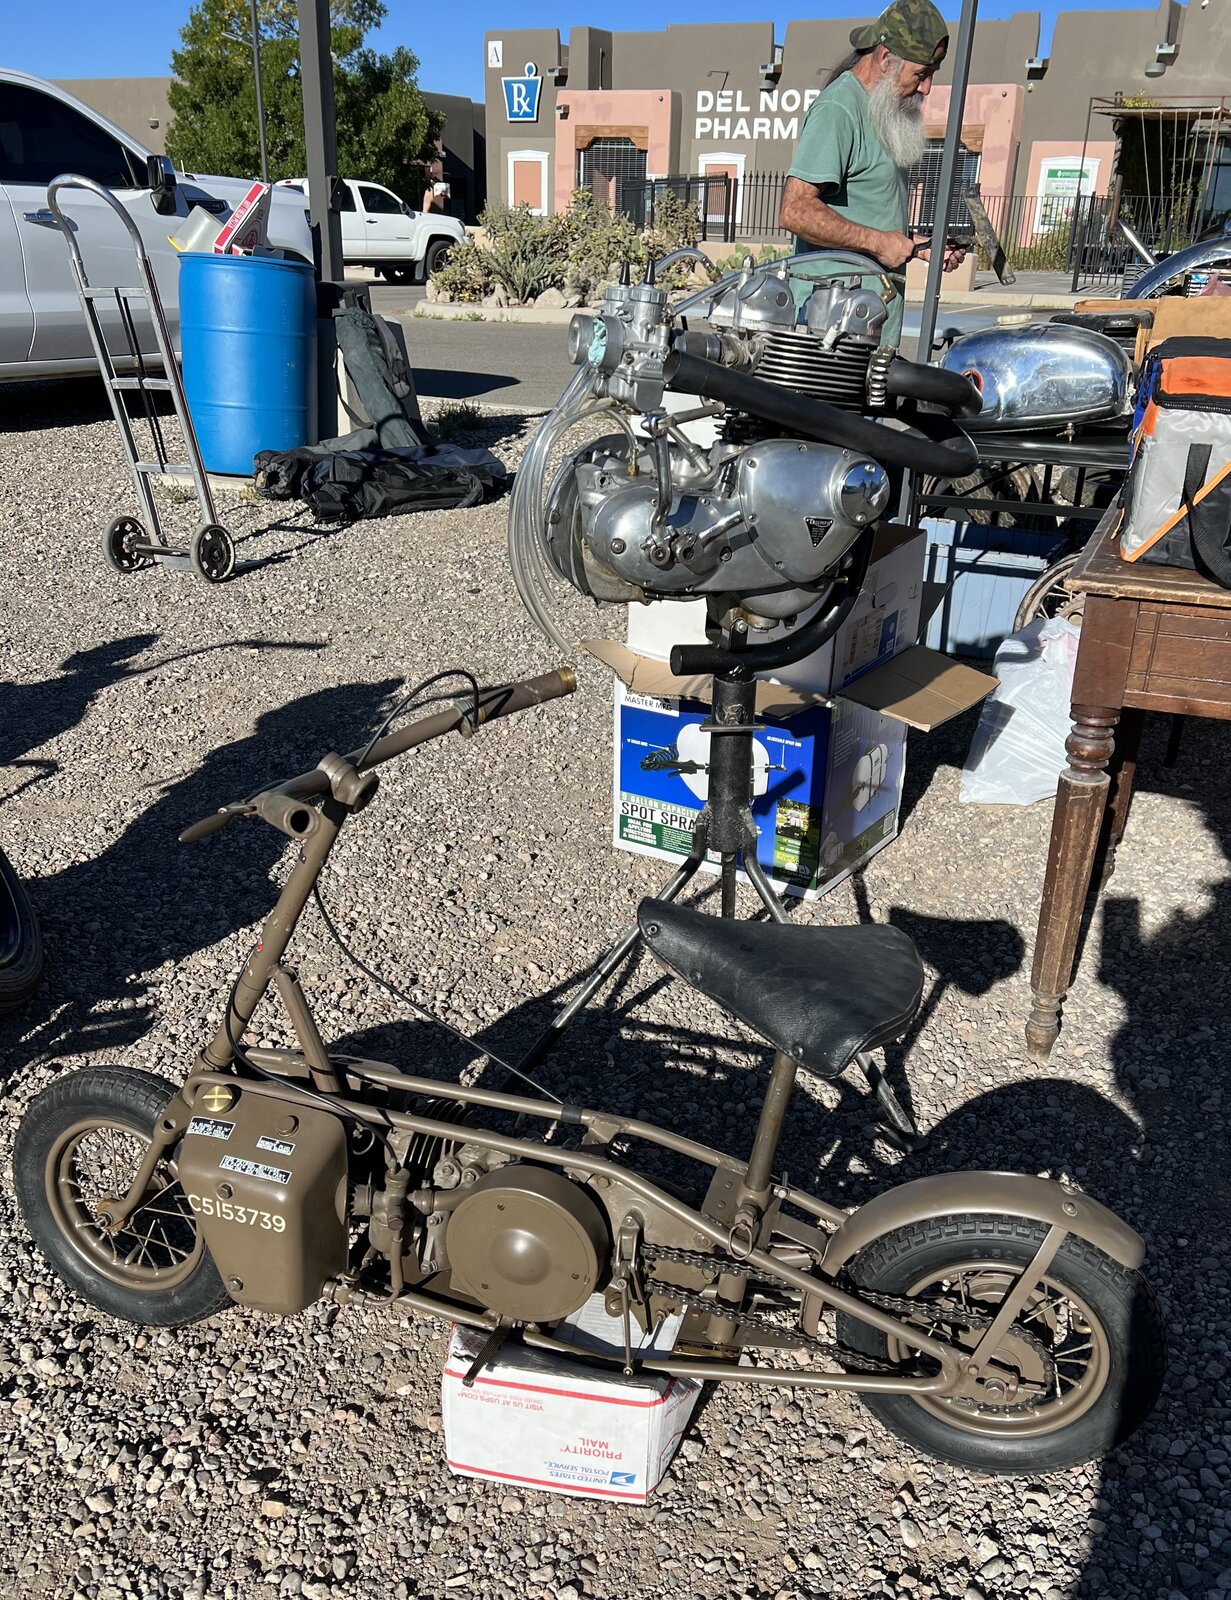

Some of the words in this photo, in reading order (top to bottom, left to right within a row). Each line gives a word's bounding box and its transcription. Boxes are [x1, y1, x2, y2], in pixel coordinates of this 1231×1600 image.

[697, 90, 750, 112] DEL
[695, 117, 798, 139] PHARM
[624, 695, 653, 707] MASTER
[656, 702, 672, 711] MFG
[621, 802, 656, 821] SPOT
[630, 795, 659, 809] GALLON
[662, 803, 699, 819] CAPACITY
[187, 1194, 287, 1233] C5153739
[525, 1403, 543, 1412] VISIT
[579, 1437, 608, 1449] MAIL
[563, 1444, 622, 1460] PRIORITY
[547, 1461, 578, 1472] SERVICE
[581, 1467, 609, 1476] POSTAL
[549, 1471, 575, 1480] STATES
[577, 1475, 607, 1484] UNITED
